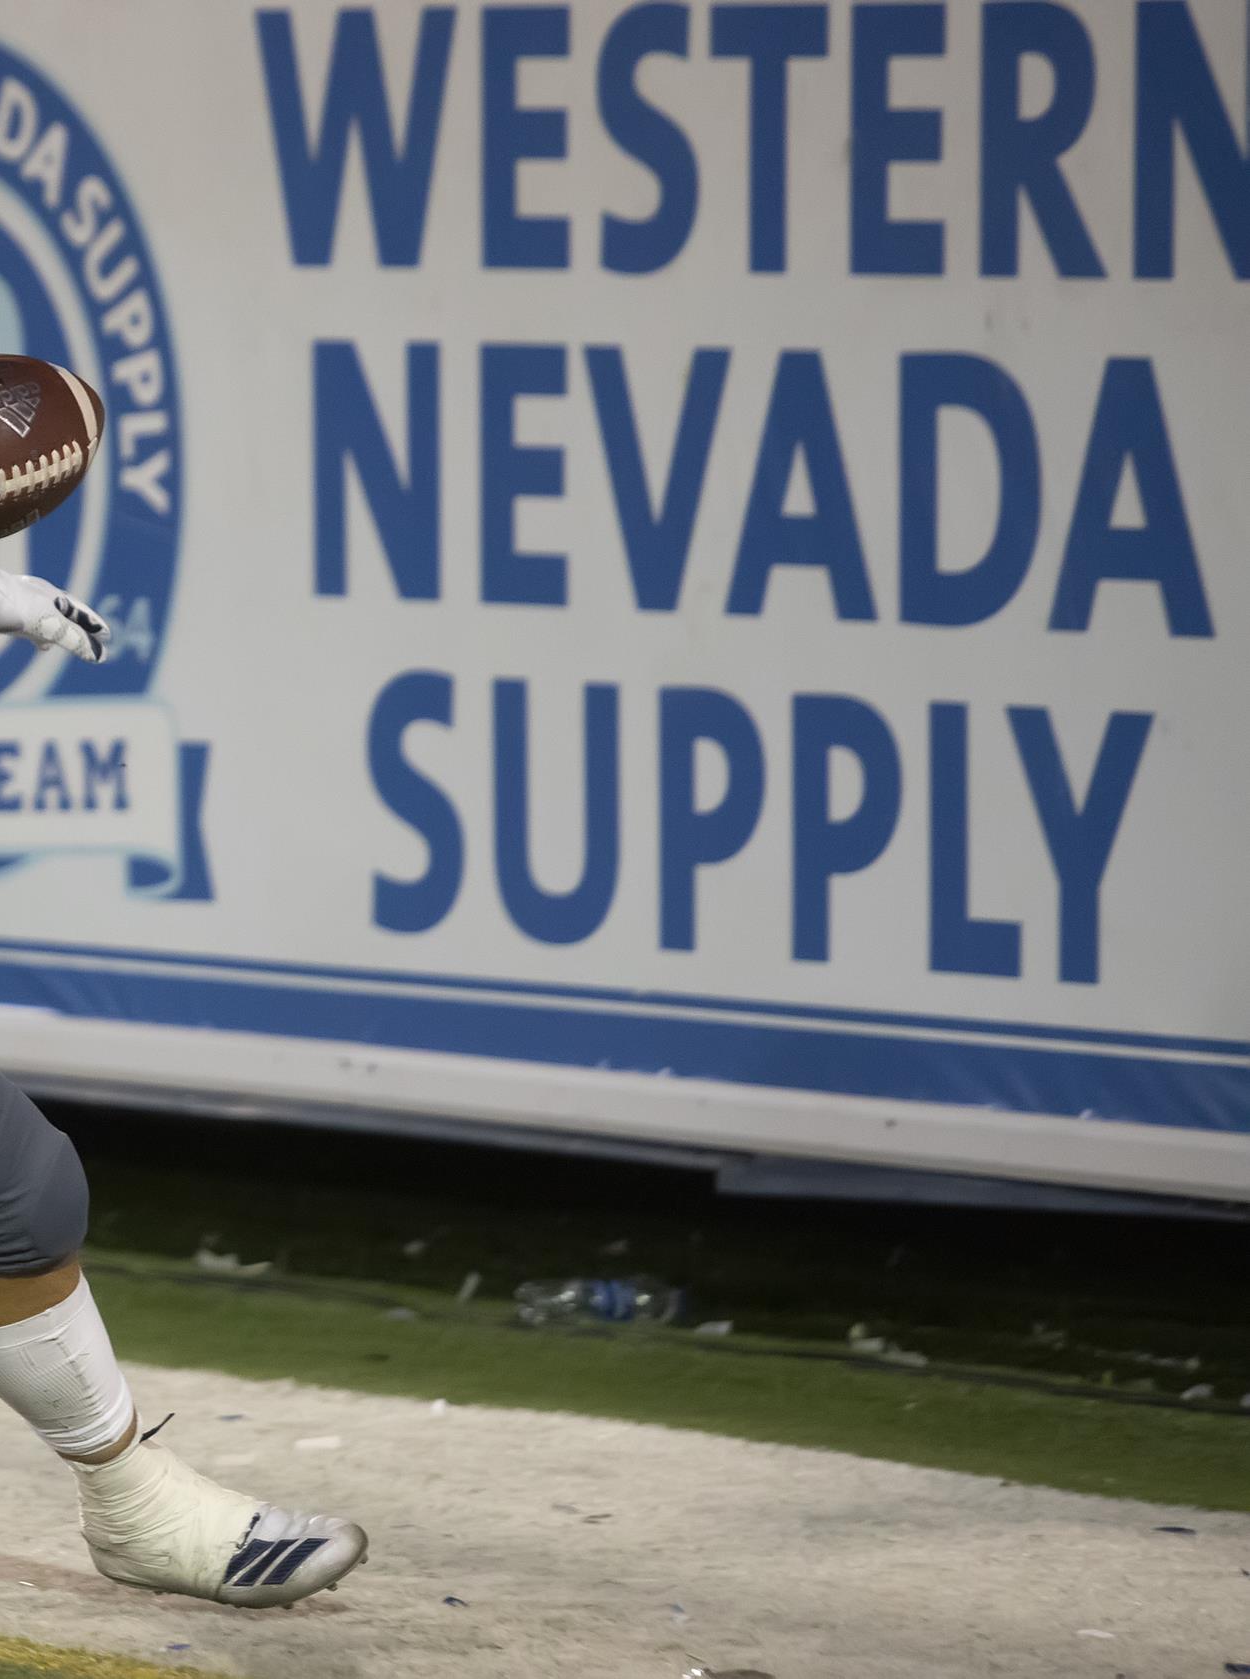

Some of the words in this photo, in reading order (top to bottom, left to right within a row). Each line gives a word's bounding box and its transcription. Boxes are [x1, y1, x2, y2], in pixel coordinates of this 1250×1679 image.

[254, 0, 1250, 281] WESTERN
[60, 173, 171, 514] SUPPLY
[312, 339, 1215, 639] NEVADA
[365, 668, 1155, 985] SUPPLY
